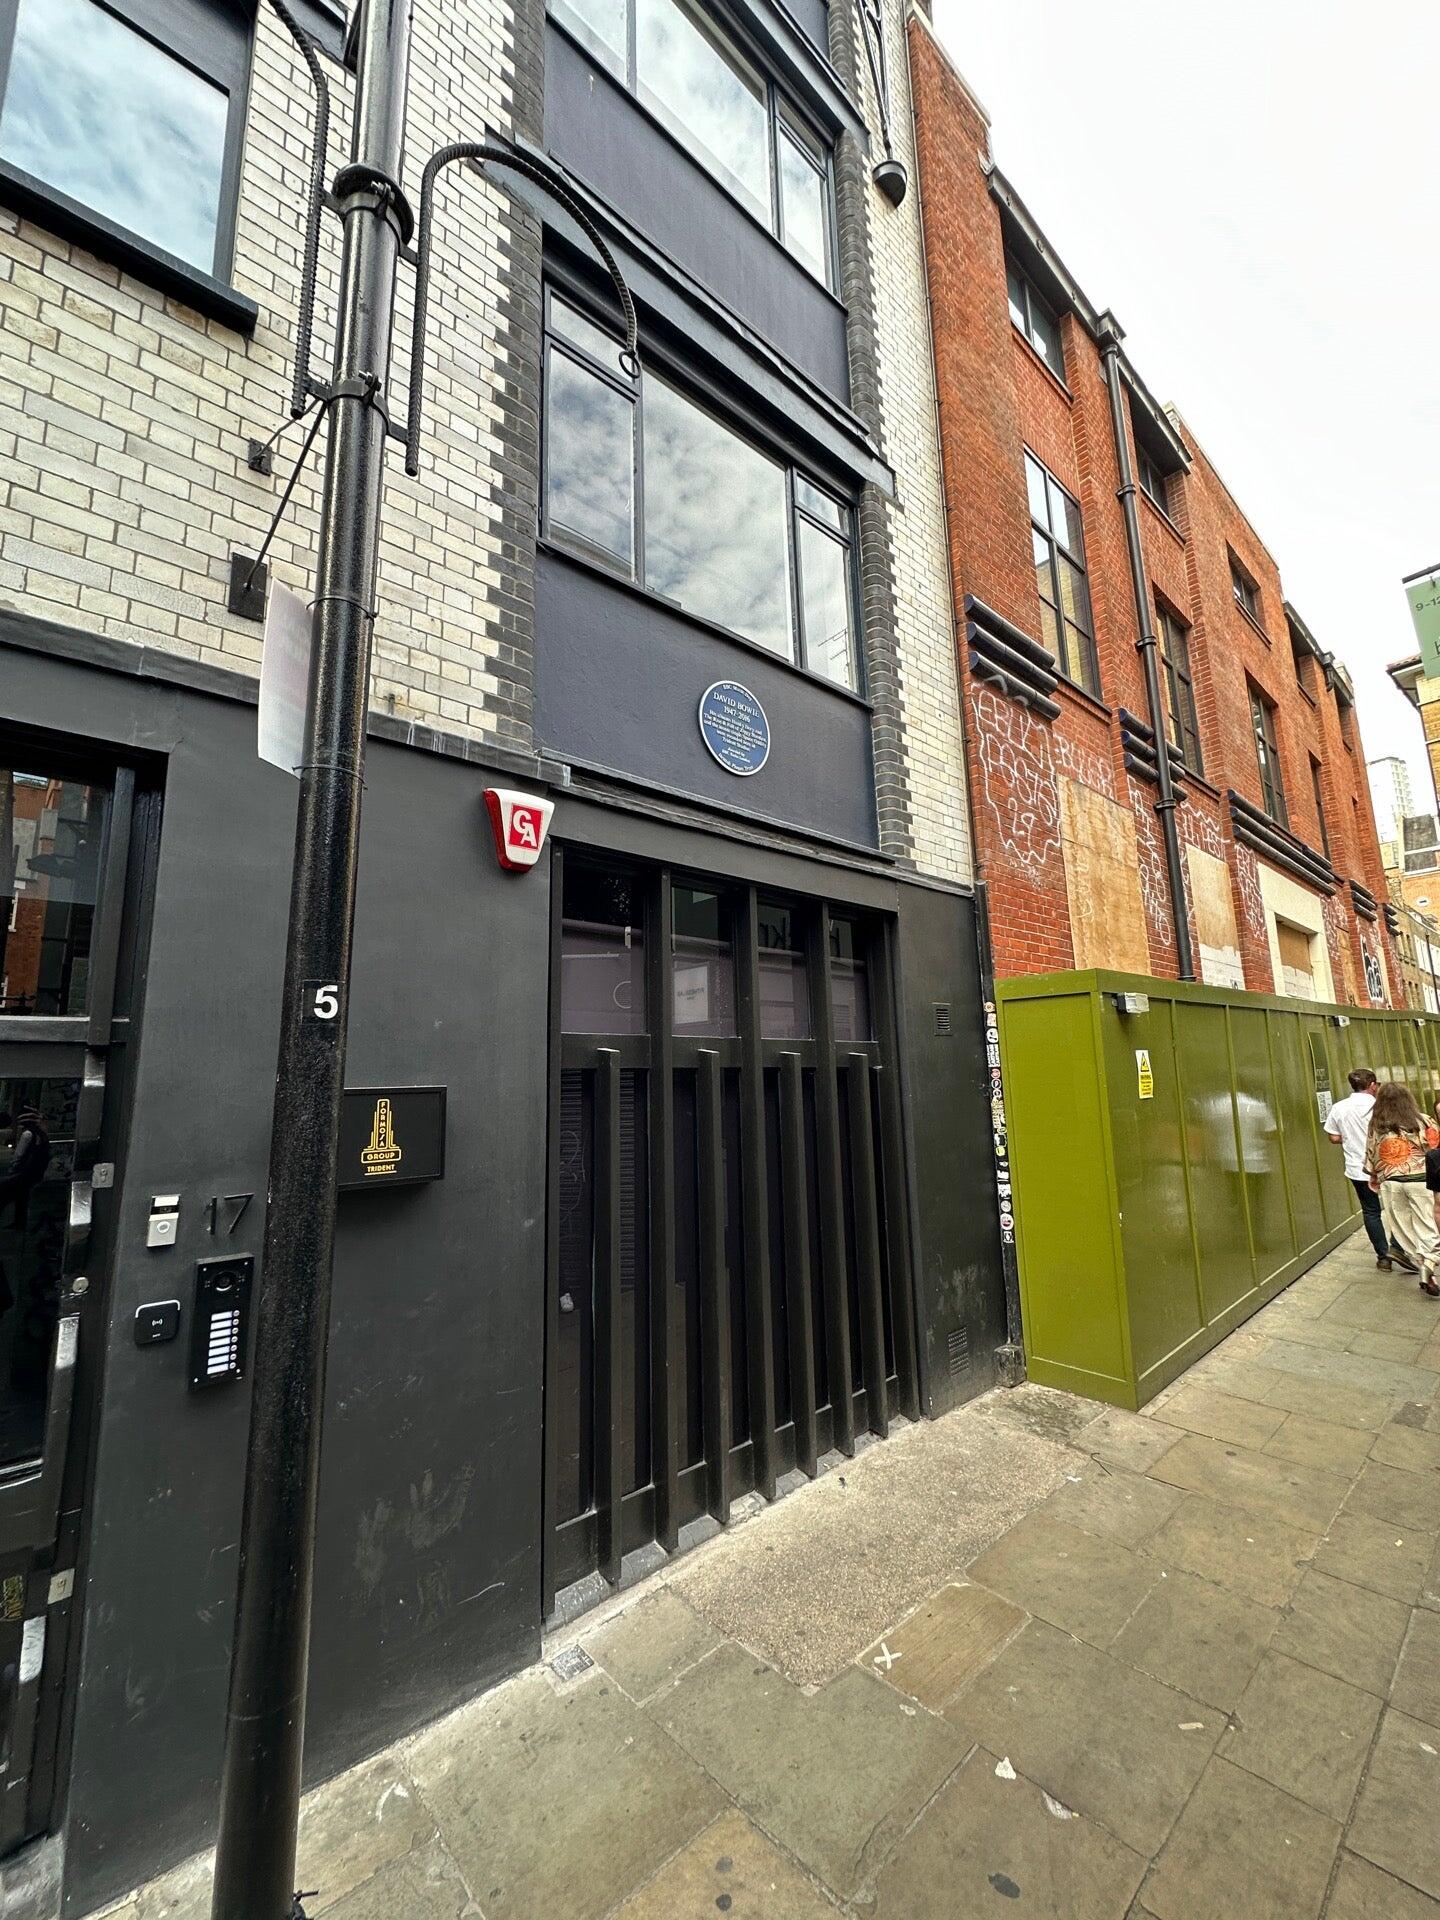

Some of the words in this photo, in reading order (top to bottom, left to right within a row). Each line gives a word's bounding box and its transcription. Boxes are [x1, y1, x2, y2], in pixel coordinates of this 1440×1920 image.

[713, 691, 736, 707] DAVID
[737, 702, 760, 718] BOWIE
[512, 809, 538, 848] GA
[313, 984, 339, 1019] 5
[379, 1101, 388, 1147] FORMOSA
[366, 1152, 396, 1160] GROUP
[367, 1164, 396, 1173] TRIDENT
[204, 1193, 255, 1235] 17
